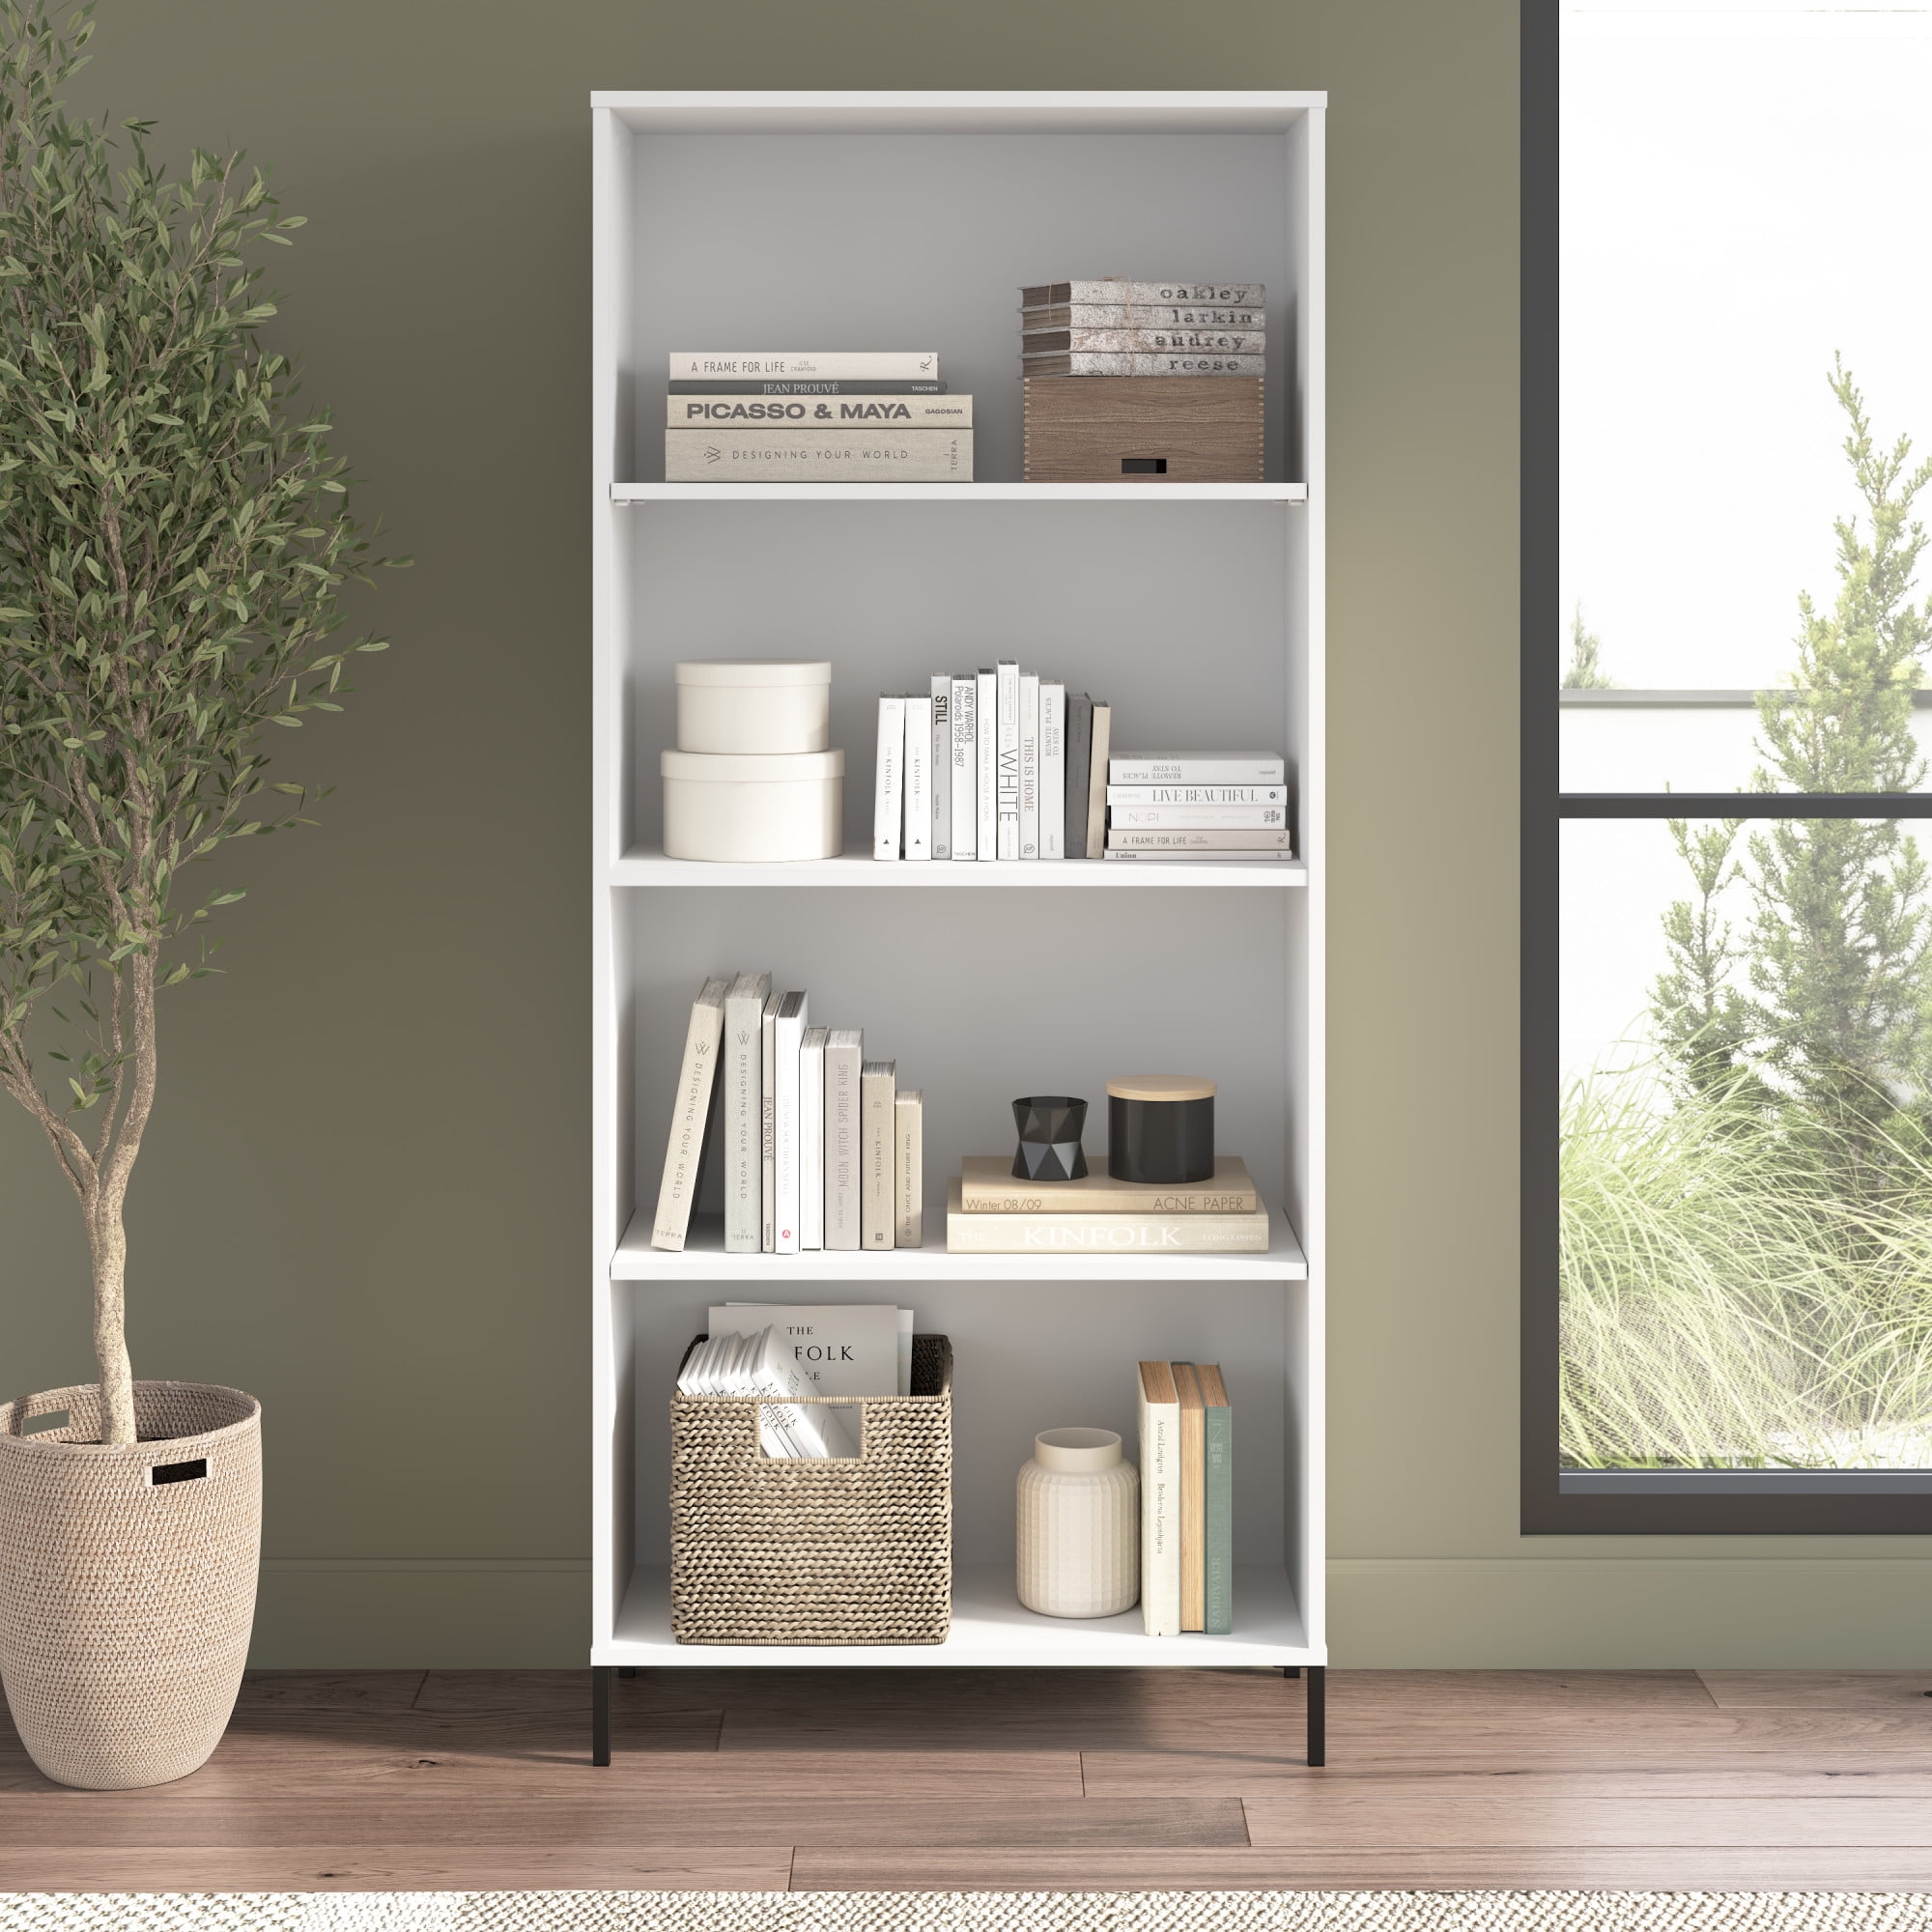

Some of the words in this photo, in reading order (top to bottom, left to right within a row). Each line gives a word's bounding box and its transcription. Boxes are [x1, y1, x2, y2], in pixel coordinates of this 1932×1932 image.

[1160, 286, 1247, 303] oakley
[1173, 309, 1252, 324] larkin
[1155, 334, 1246, 349] audrey
[691, 361, 698, 373] A
[703, 361, 738, 373] FRAME
[742, 361, 761, 373] FOR
[765, 361, 785, 373] LIFE
[1169, 358, 1238, 371] reese
[763, 384, 790, 395] JEAN
[793, 381, 839, 394] PROUVÉ
[687, 403, 806, 419] PICASSO
[813, 403, 833, 419] &
[840, 403, 912, 419] MAYA
[732, 450, 808, 460] DESIGNING
[816, 450, 851, 460] YOUR
[863, 450, 908, 460] WORLD
[954, 686, 964, 722] Polaroids
[964, 686, 974, 709] ANDY
[935, 696, 948, 725] STILL
[964, 710, 974, 745] WARHOL
[1024, 737, 1034, 762] THIS
[1052, 747, 1060, 756] TO
[1024, 765, 1034, 776] IS
[999, 749, 1018, 822] WHITE
[1024, 780, 1034, 811] HOME
[1152, 789, 1182, 802] LIVE
[1185, 789, 1259, 802] BEAUTIFUL
[1173, 837, 1186, 845] LIFE
[838, 1064, 849, 1086] KING
[686, 1063, 702, 1122] DESIGNING
[763, 1096, 773, 1120] JEAN
[838, 1090, 849, 1122] SPIDER
[680, 1127, 691, 1155] YOUR
[763, 1122, 775, 1161] PROUVÉ
[838, 1127, 849, 1155] WITCH
[672, 1163, 686, 1199] WORLD
[838, 1161, 849, 1187] MOON
[966, 1199, 1001, 1210] Winter
[1004, 1199, 1042, 1210] 08/09
[1153, 1196, 1195, 1209] ACNE
[1204, 1196, 1244, 1209] PAPER
[1022, 1227, 1183, 1246] KINFOLK
[786, 1326, 813, 1335] THE
[795, 1346, 855, 1361] FOLK
[1155, 1443, 1165, 1474] Lindgren
